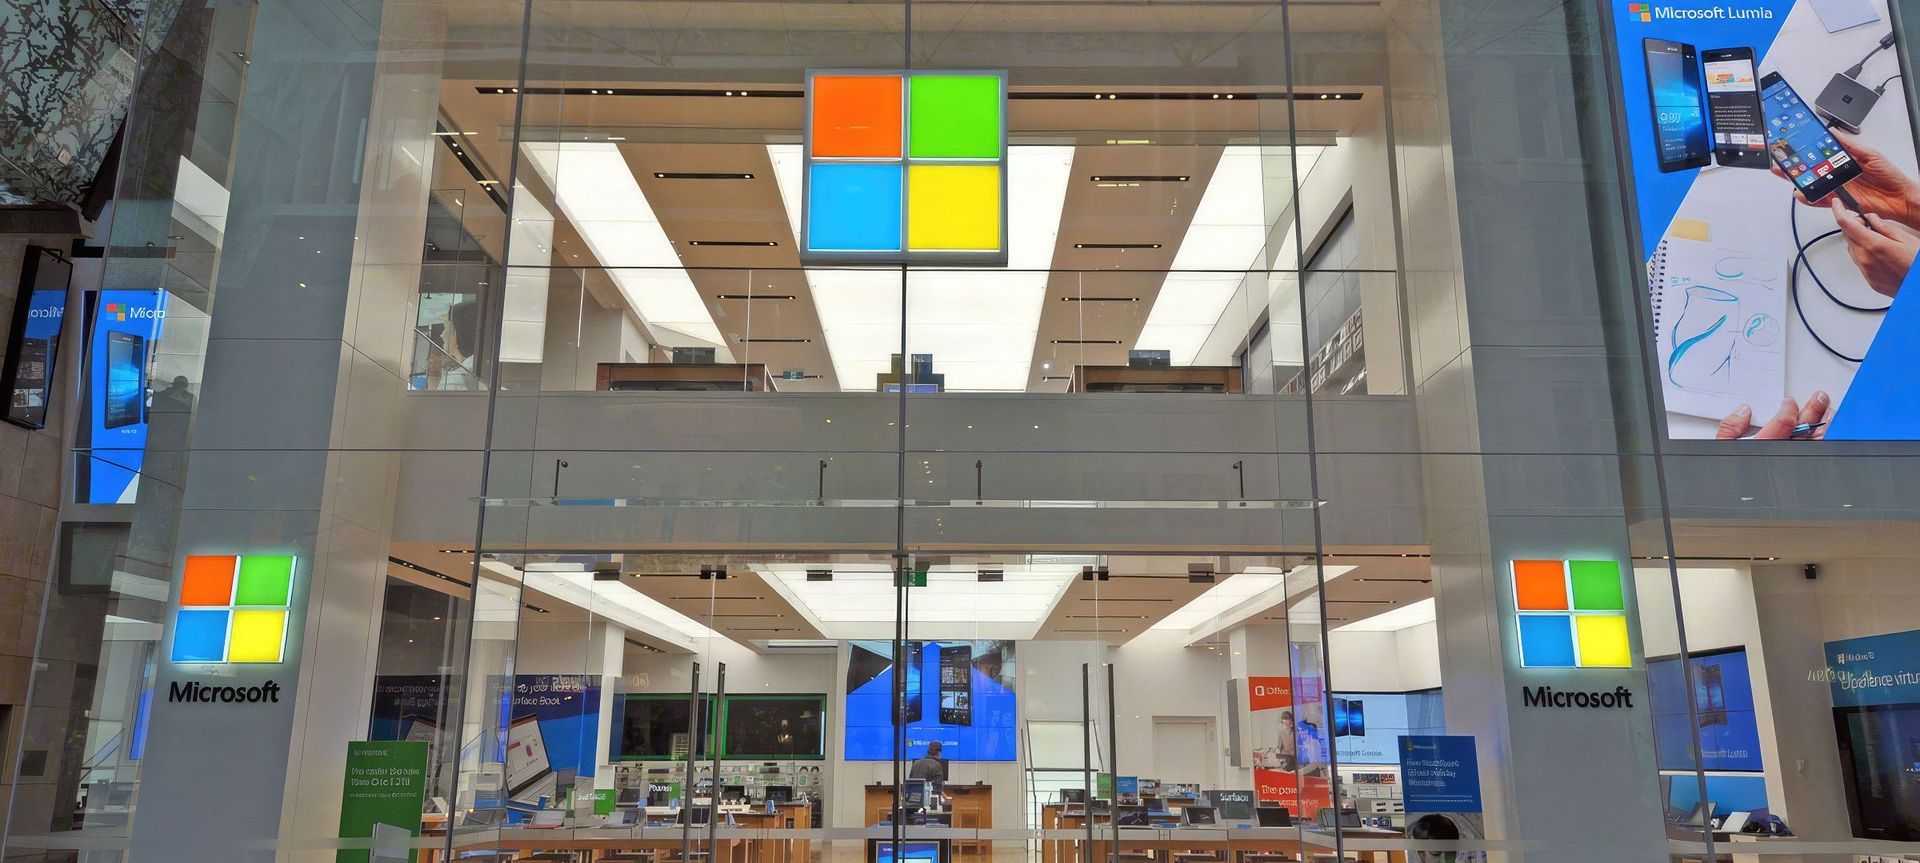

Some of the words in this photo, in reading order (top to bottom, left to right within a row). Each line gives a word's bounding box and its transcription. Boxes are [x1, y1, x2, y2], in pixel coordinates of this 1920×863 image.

[1655, 6, 1725, 19] Microsoft
[1728, 6, 1773, 19] Lumia
[168, 679, 280, 703] Microsoft
[1522, 685, 1634, 708] Microsoft
